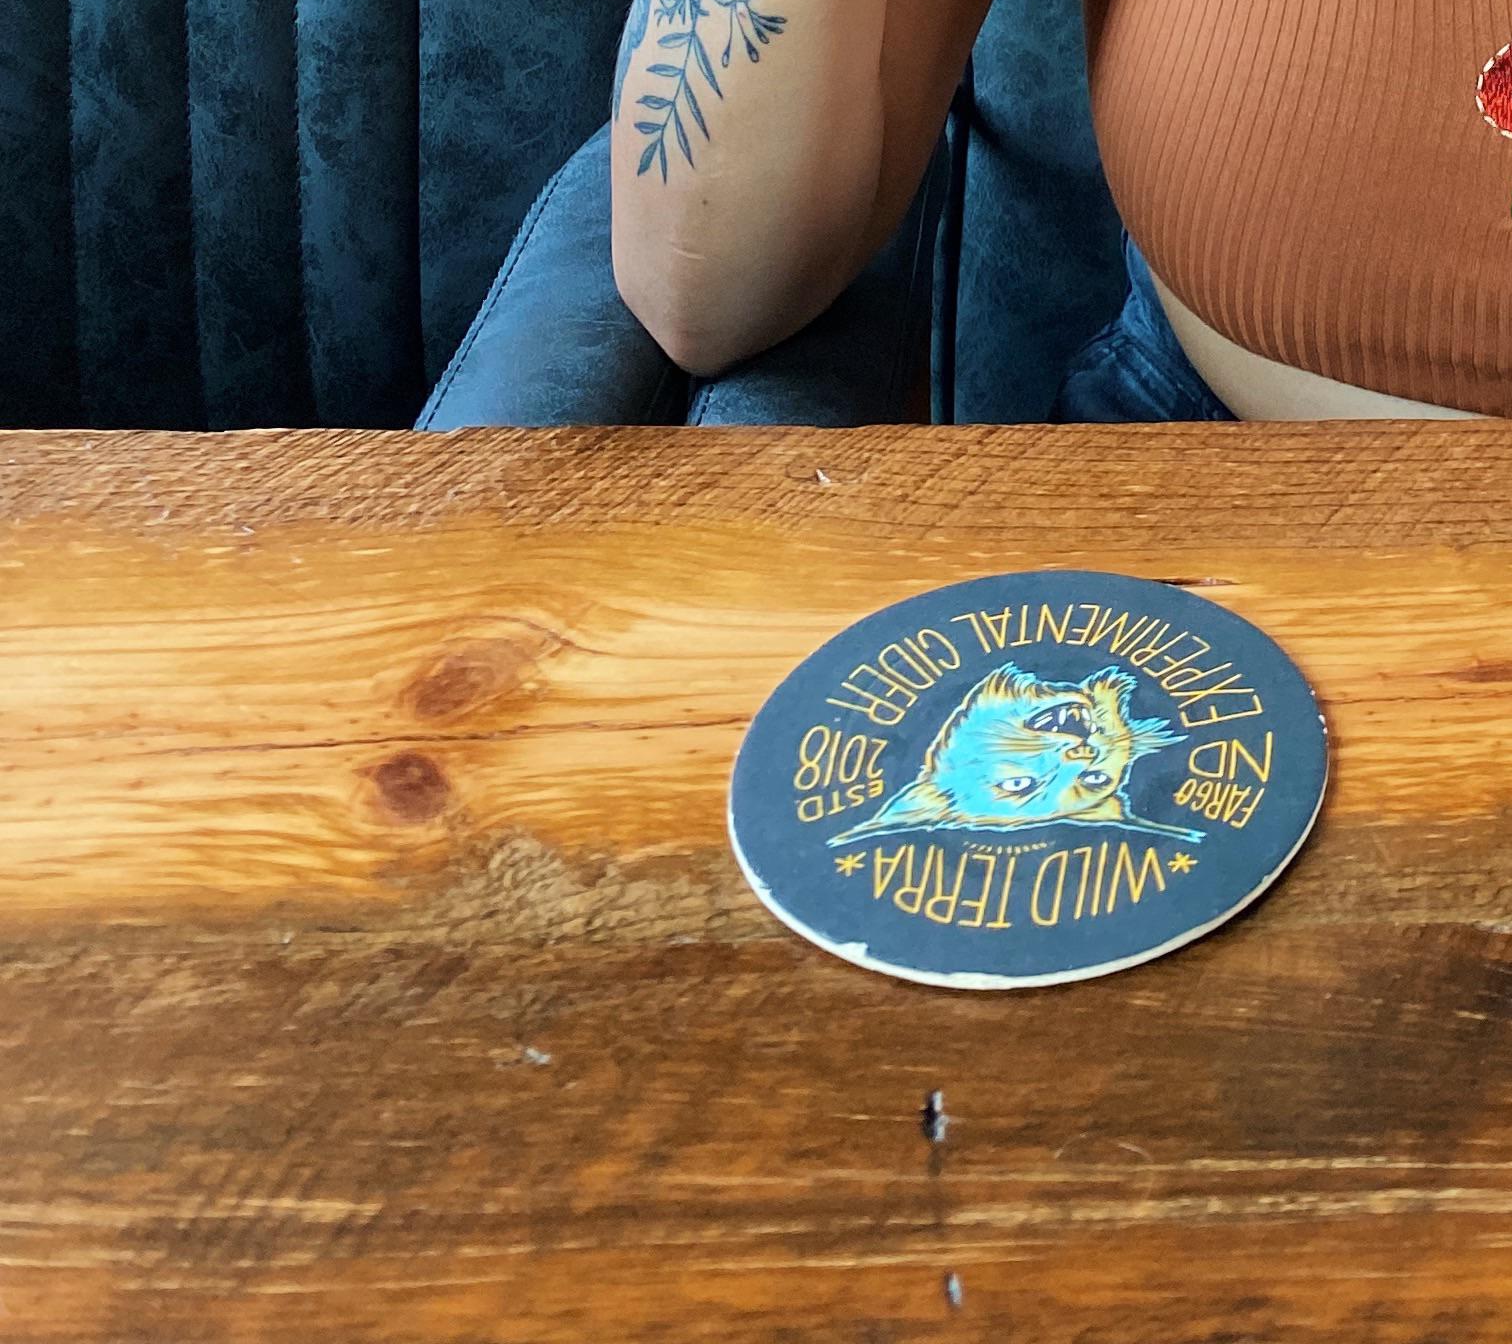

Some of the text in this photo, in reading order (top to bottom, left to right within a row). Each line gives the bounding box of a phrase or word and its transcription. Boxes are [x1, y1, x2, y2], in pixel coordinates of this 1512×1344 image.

[825, 603, 1263, 728] EXPERIMENTAL CIDER
[793, 725, 889, 791] 2018
[1188, 730, 1273, 783] ND
[1172, 778, 1265, 828] FARGO
[870, 840, 1166, 929] WILD TERRA
